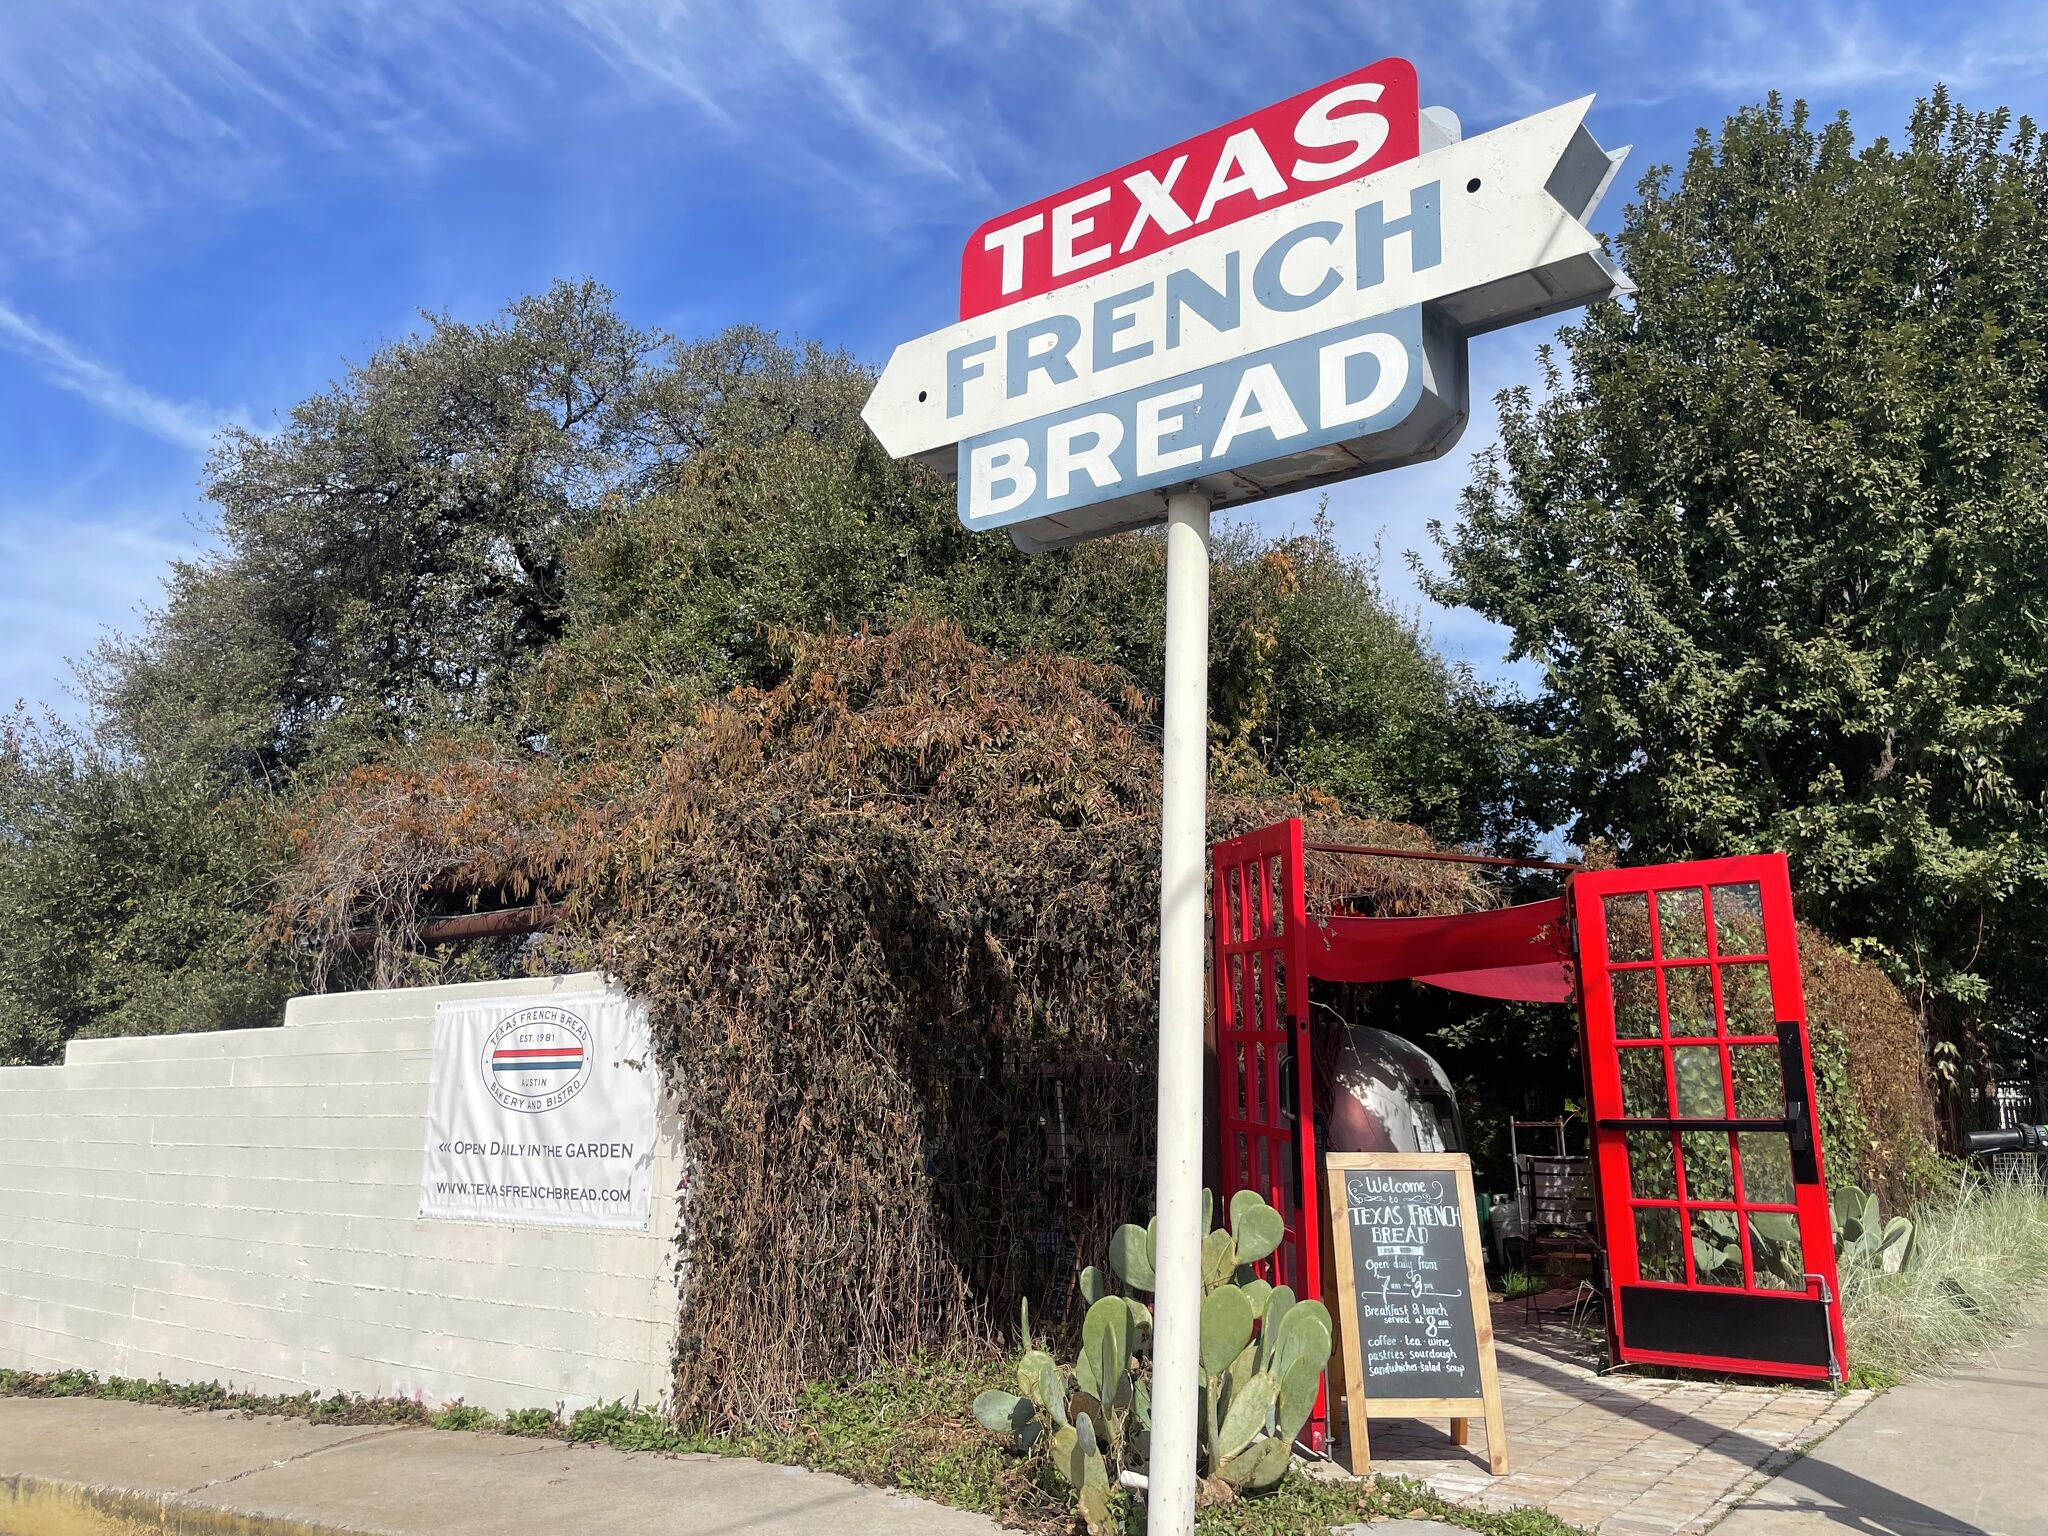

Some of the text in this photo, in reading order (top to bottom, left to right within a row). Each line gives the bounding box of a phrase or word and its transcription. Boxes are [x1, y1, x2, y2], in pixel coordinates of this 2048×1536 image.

[984, 82, 1390, 295] TEXAS
[946, 180, 1443, 419] FRENCH
[969, 332, 1409, 519] BREAD
[490, 1010, 587, 1046] TEXAS FRENCH BREAD
[519, 1033, 555, 1043] EST. 1981
[521, 1078, 547, 1087] AUSTIN
[490, 1080, 580, 1110] BAKERY AND BISTRO
[565, 1143, 634, 1158] GARDEN
[436, 1182, 631, 1203] WWW.TEXASFRENCHBREAD.COM
[1365, 1176, 1426, 1193] Welcome
[1389, 1195, 1398, 1204] to
[1348, 1204, 1462, 1227] TEXAS FRENCH
[1371, 1226, 1428, 1244] BREAD
[1365, 1255, 1438, 1279] Open daily from
[1364, 1302, 1448, 1317] Breakfast & lunch
[1384, 1315, 1411, 1324] served
[1415, 1315, 1424, 1324] at
[1368, 1335, 1451, 1347] coffee tea wine
[1410, 1347, 1458, 1363] sourdough
[1446, 1365, 1465, 1377] soup
